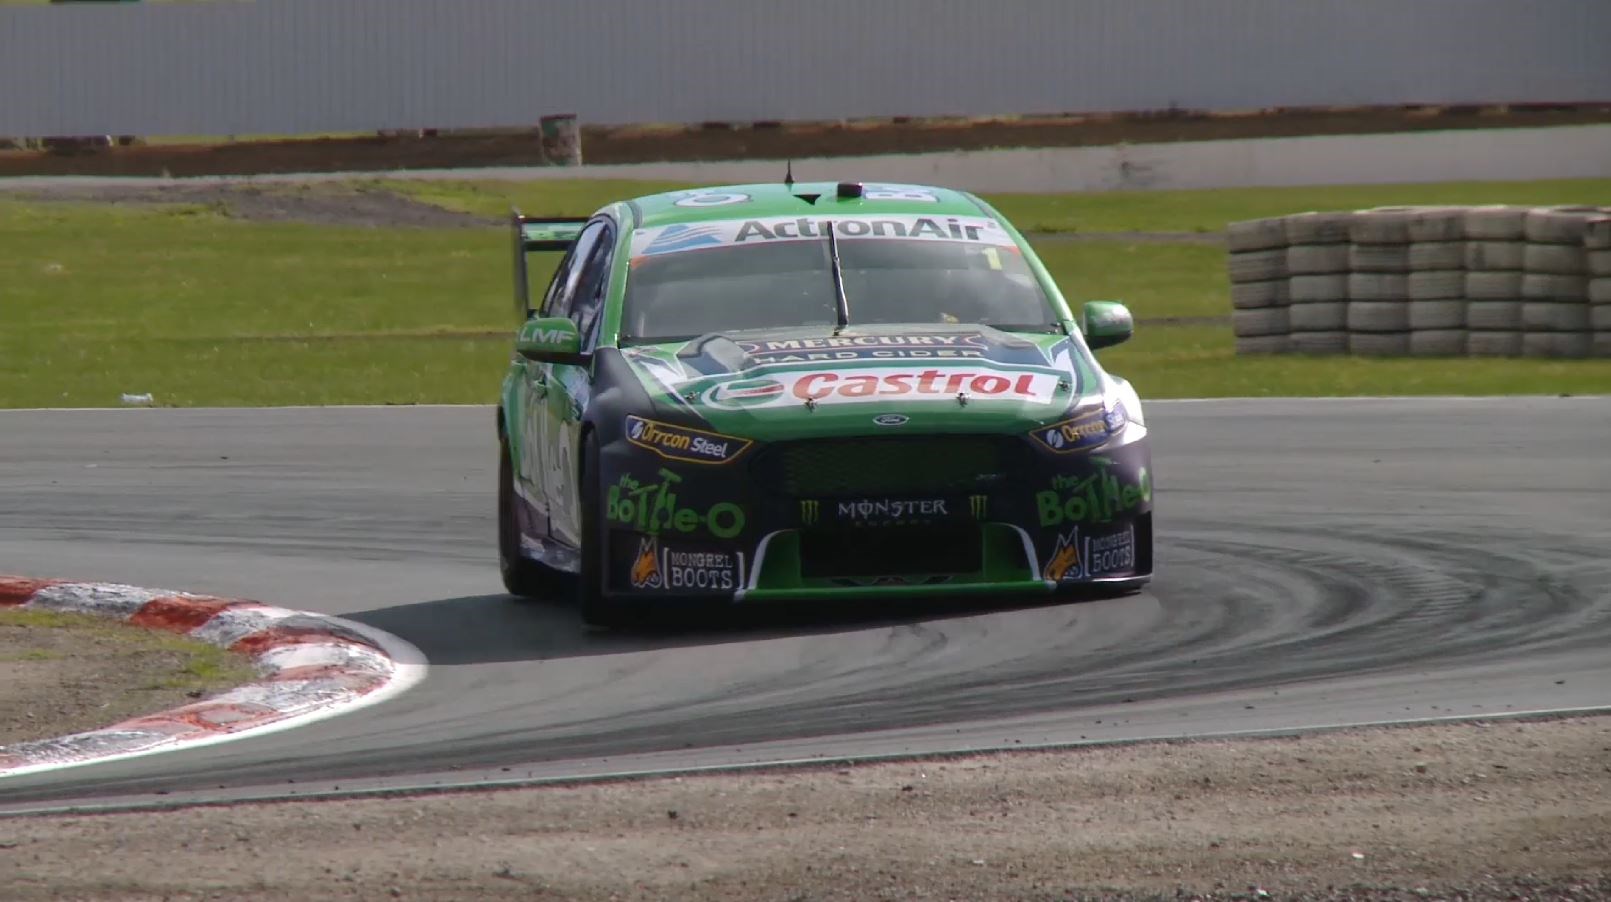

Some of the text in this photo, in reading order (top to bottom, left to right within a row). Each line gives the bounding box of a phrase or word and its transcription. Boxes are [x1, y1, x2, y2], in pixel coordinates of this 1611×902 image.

[735, 218, 982, 242] ActronAir
[981, 248, 1002, 270] 1
[519, 327, 575, 345] LMF
[771, 335, 957, 350] MERCURY
[755, 350, 986, 364] HARD CIDER
[794, 370, 1036, 400] Castrol
[642, 422, 728, 458] Orrcon Steel
[620, 472, 639, 490] the
[838, 499, 949, 519] MONSTER
[671, 552, 733, 568] MONGREL
[1092, 546, 1131, 573] BOOTS
[671, 569, 733, 589] BOOTS
